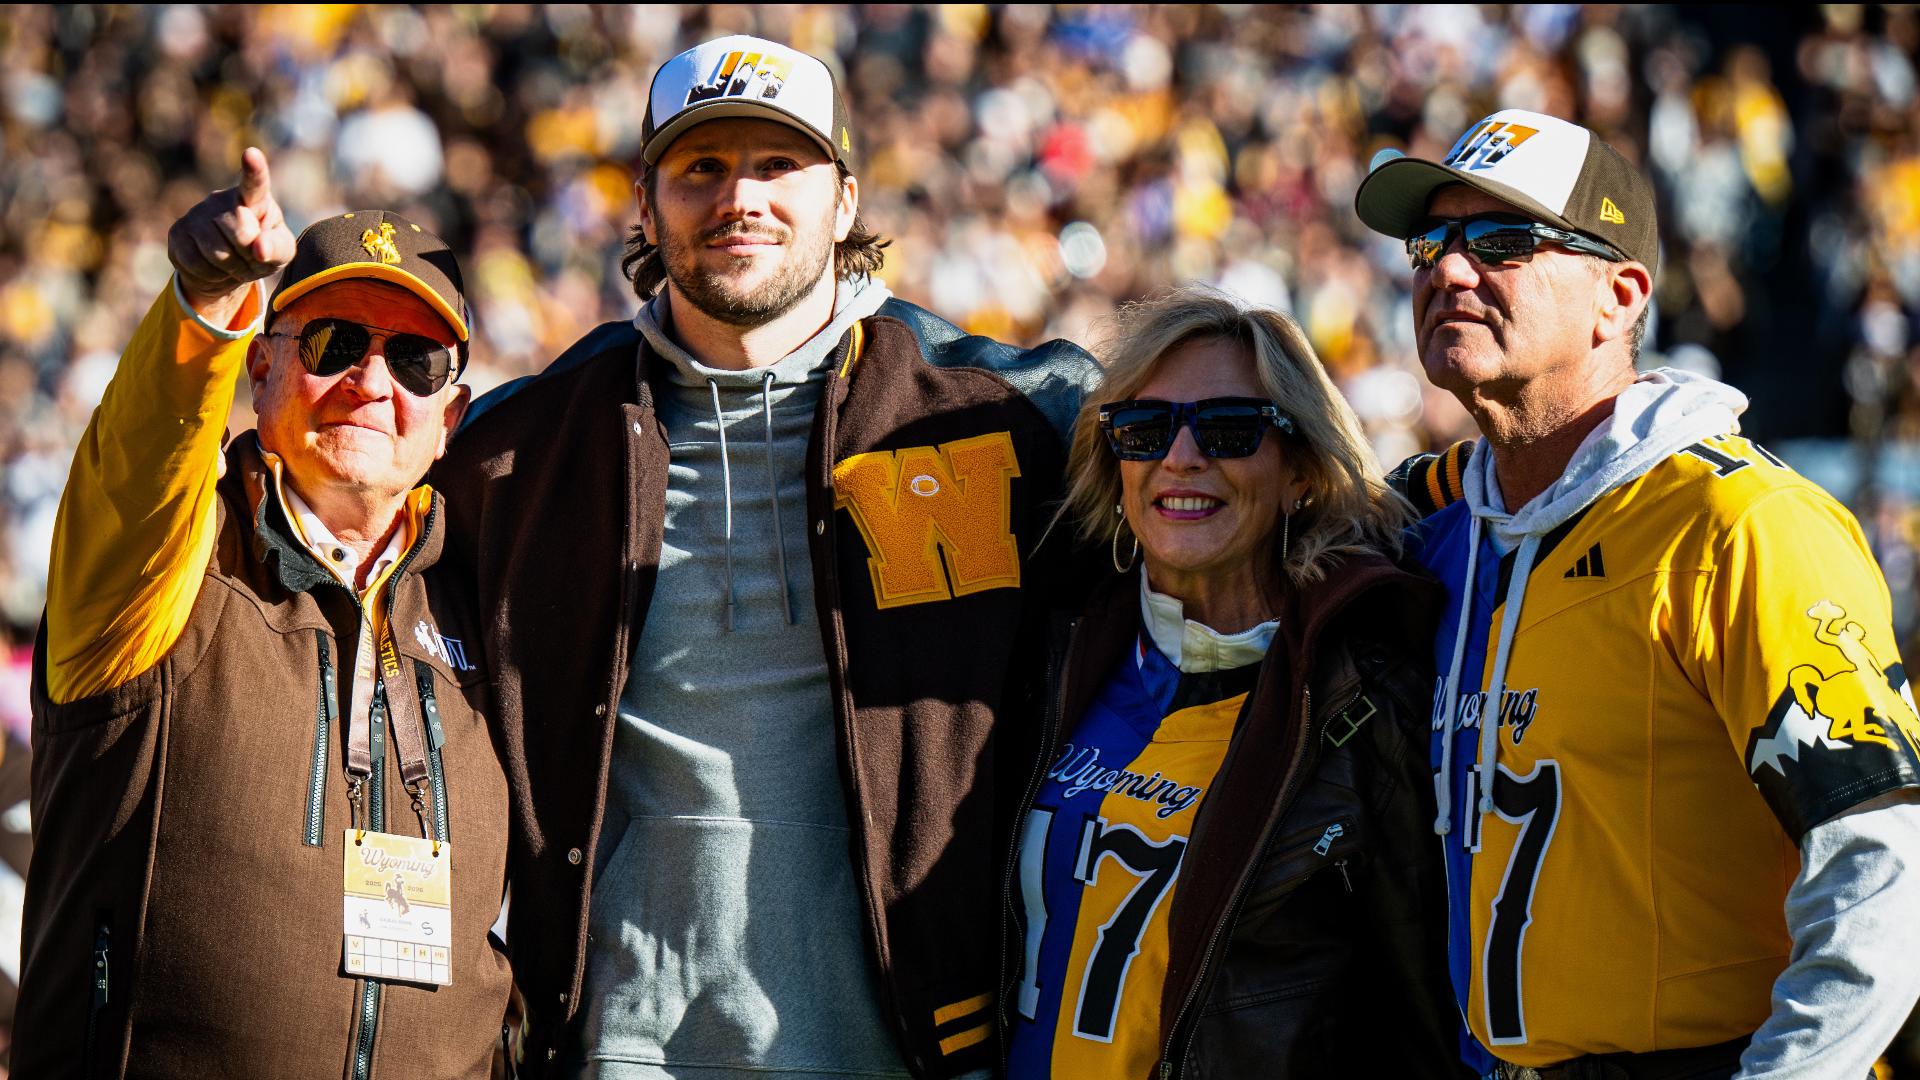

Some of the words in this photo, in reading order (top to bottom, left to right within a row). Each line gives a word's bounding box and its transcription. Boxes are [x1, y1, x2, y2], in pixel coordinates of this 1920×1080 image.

[832, 430, 1022, 610] W
[1047, 743, 1202, 821] Wyoming
[361, 847, 435, 878] Wyoming
[421, 921, 434, 936] S
[1017, 804, 1189, 1044] 17
